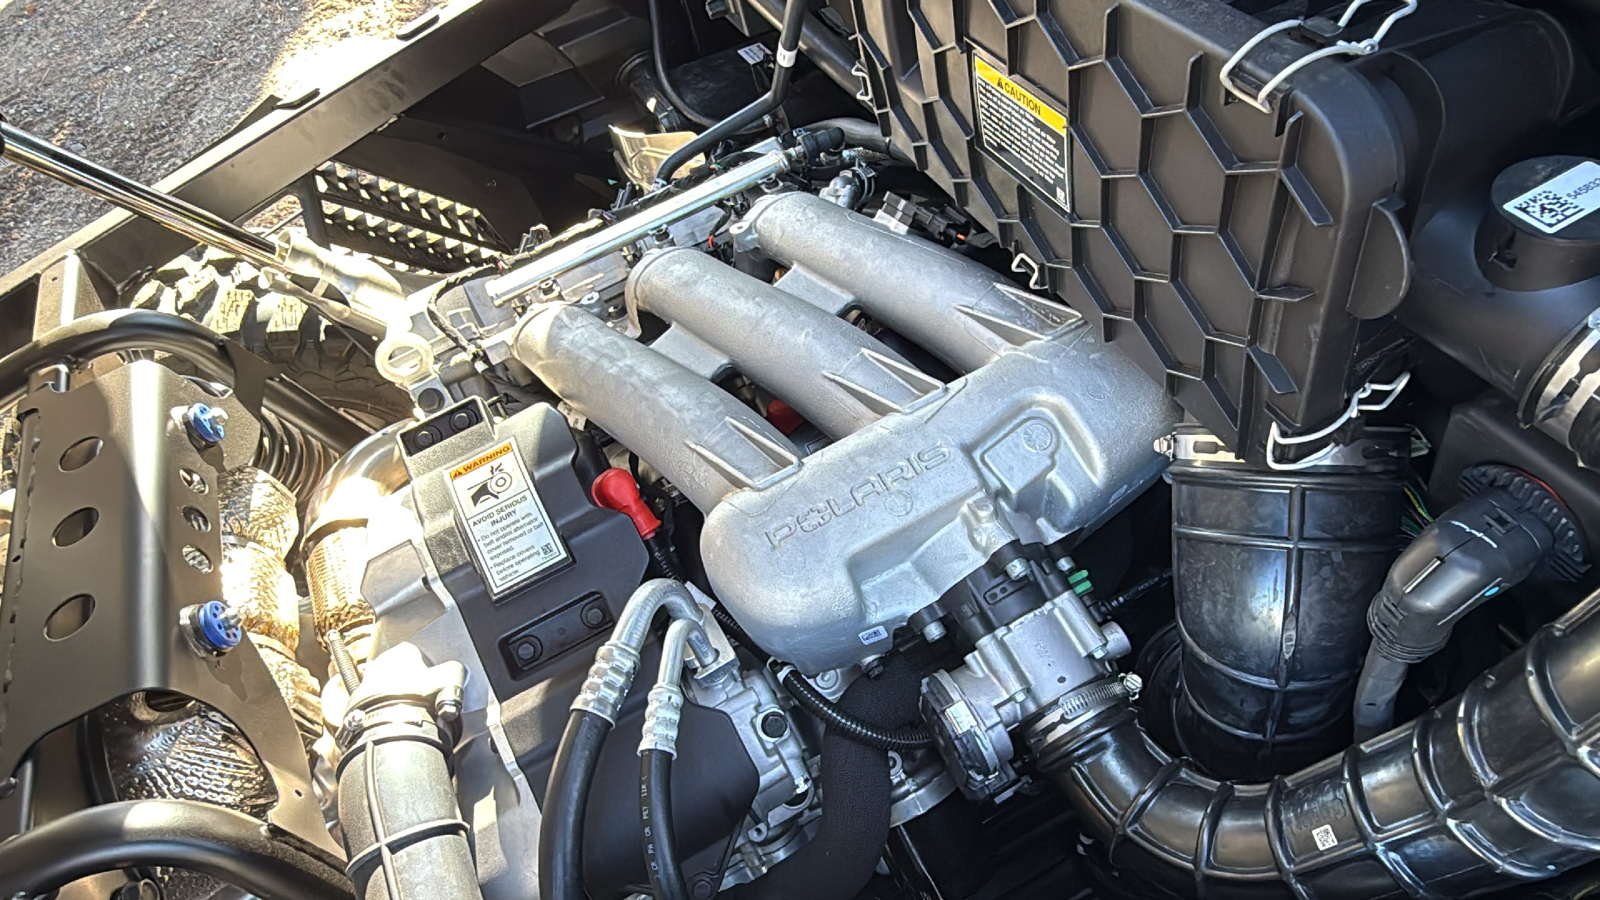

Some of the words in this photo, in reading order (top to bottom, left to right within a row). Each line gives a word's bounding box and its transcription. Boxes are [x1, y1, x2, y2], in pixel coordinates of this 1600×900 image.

[1004, 82, 1041, 116] CAUTION
[462, 445, 510, 472] WARNING
[765, 441, 950, 548] POLARIS
[472, 511, 494, 527] AVOID
[495, 494, 528, 516] SERIOUS
[490, 508, 517, 526] INJURY
[481, 533, 490, 541] Do
[490, 528, 500, 536] not
[500, 518, 522, 532] operate
[520, 512, 533, 520] with
[483, 540, 495, 548] belt
[496, 530, 513, 542] and/or
[513, 517, 539, 533] alternator
[486, 545, 502, 554] cover
[502, 530, 528, 546] removed
[534, 522, 544, 531] belt
[493, 554, 516, 568] Replace
[516, 545, 535, 557] covers
[496, 564, 514, 576] before
[514, 550, 540, 566] operating
